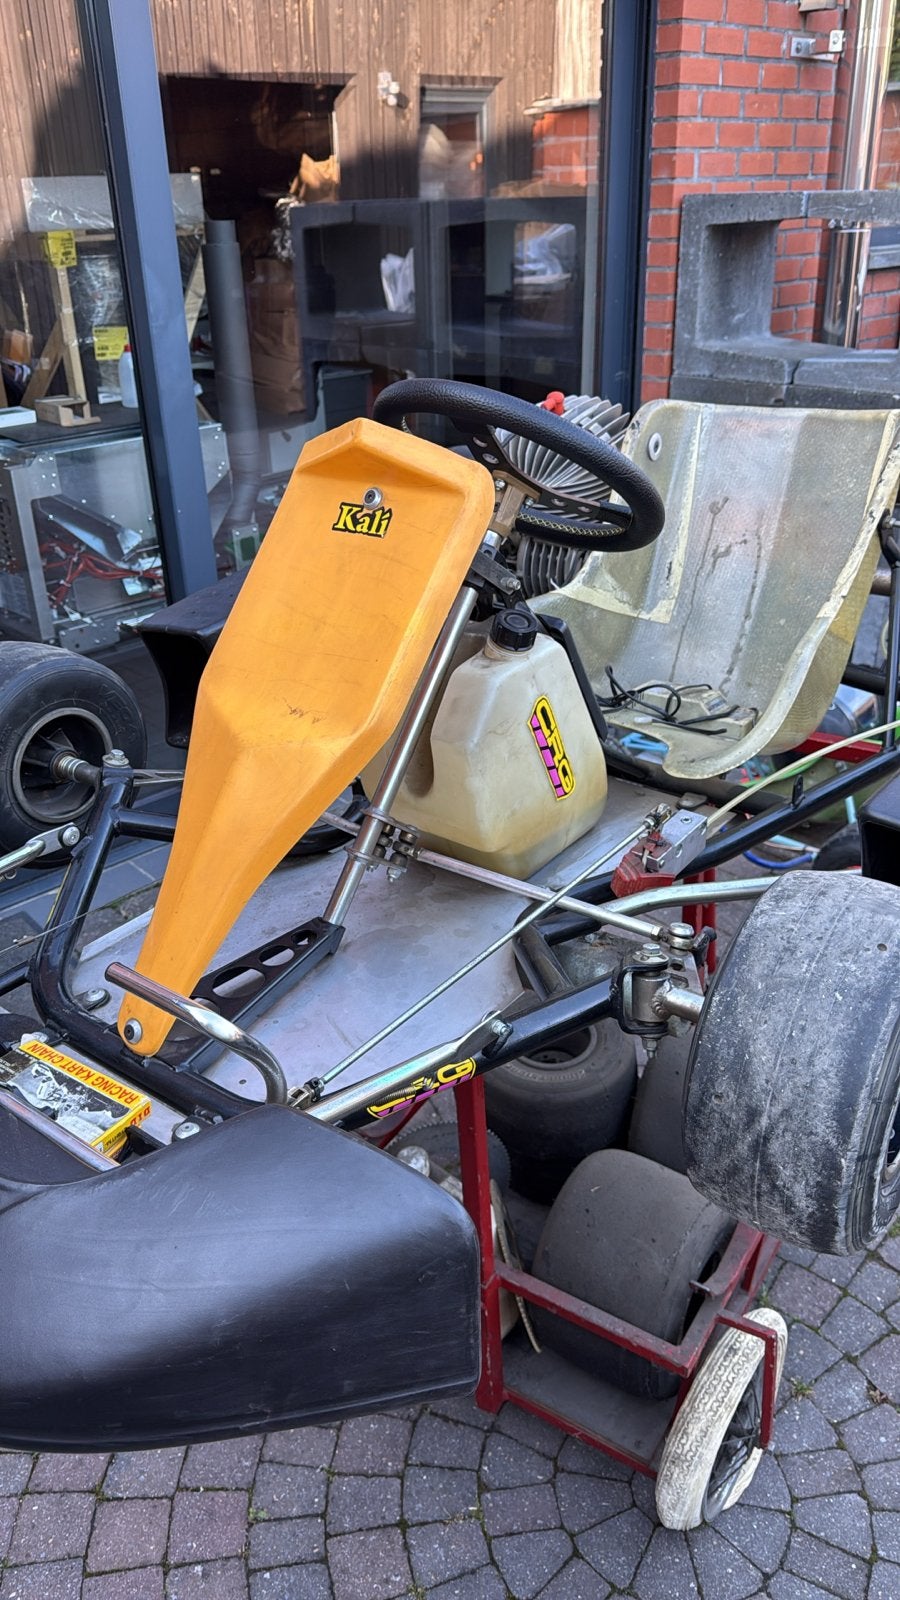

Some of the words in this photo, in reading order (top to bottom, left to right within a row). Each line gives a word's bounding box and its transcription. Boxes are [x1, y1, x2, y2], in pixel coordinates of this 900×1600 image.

[534, 696, 575, 795] CRG
[27, 1043, 65, 1064] CHAIN
[60, 1062, 95, 1081] KART
[91, 1076, 139, 1104] RACING
